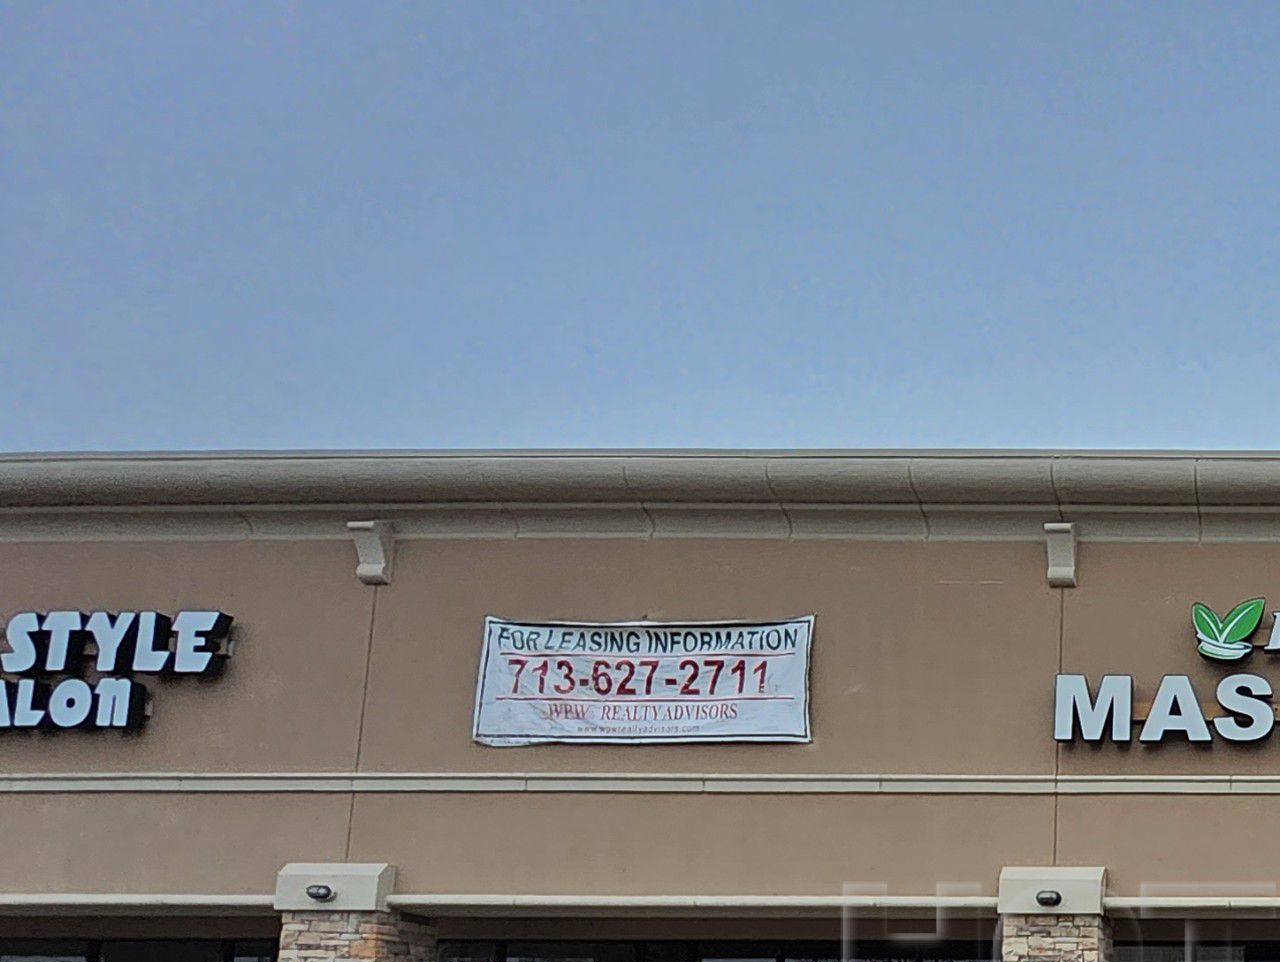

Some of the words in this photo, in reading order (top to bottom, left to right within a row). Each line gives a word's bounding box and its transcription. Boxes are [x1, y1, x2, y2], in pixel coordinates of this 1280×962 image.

[0, 610, 220, 672] STYLE
[498, 627, 539, 651] FOR
[543, 628, 641, 652] LEASING
[646, 627, 799, 653] INFORMATION
[507, 659, 769, 696] 713-627-2711
[600, 703, 663, 721] REALTY
[663, 702, 738, 721] ADVISORS
